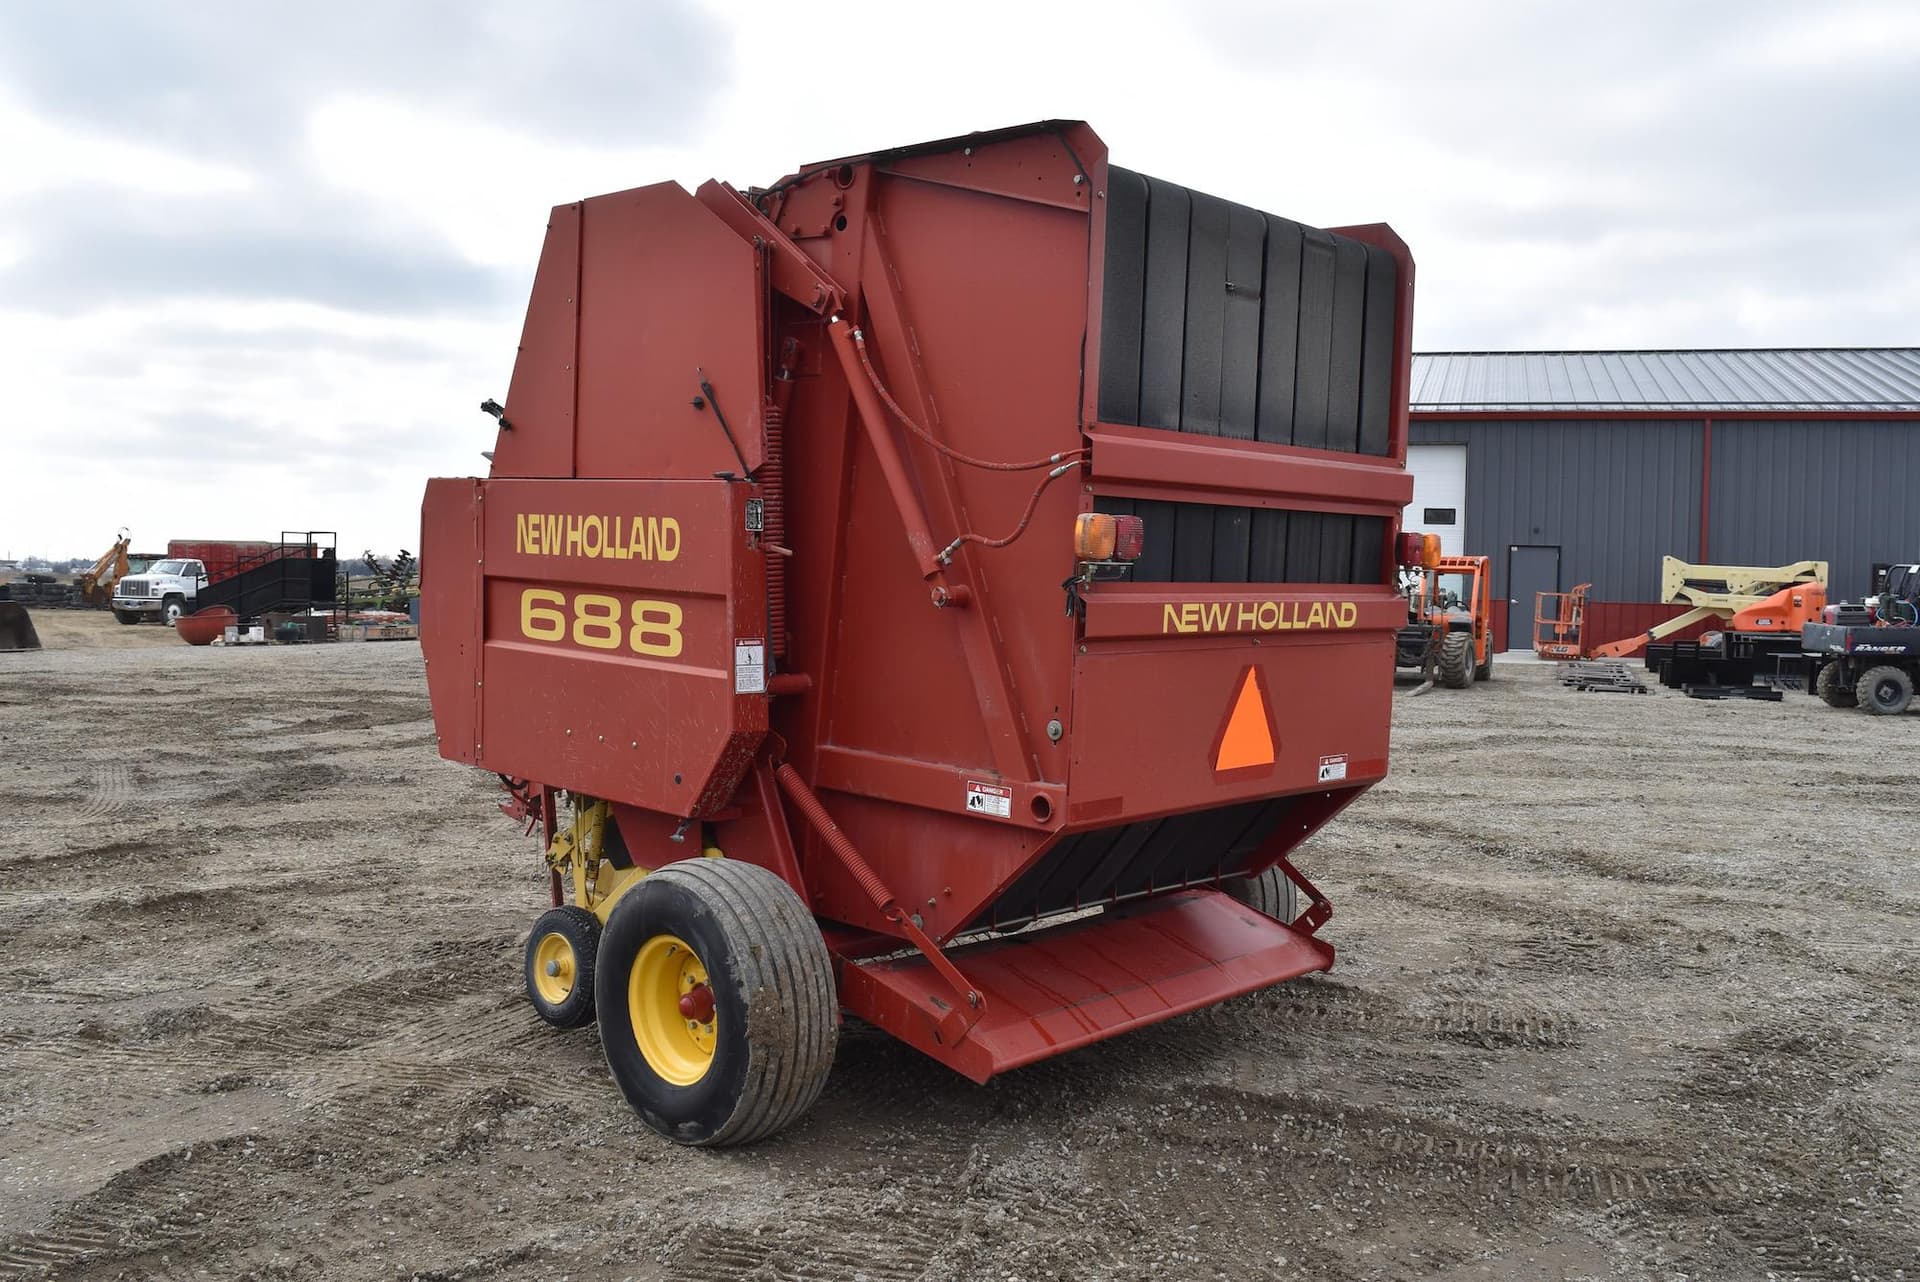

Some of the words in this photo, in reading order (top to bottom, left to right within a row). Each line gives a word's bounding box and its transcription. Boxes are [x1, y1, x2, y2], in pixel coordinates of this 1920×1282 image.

[516, 514, 563, 555] NEW
[566, 515, 681, 562] HOLLAND
[520, 588, 683, 658] 688
[1163, 602, 1232, 633] NEW
[1237, 601, 1357, 630] HOLLAND
[982, 785, 1004, 796] DANGER
